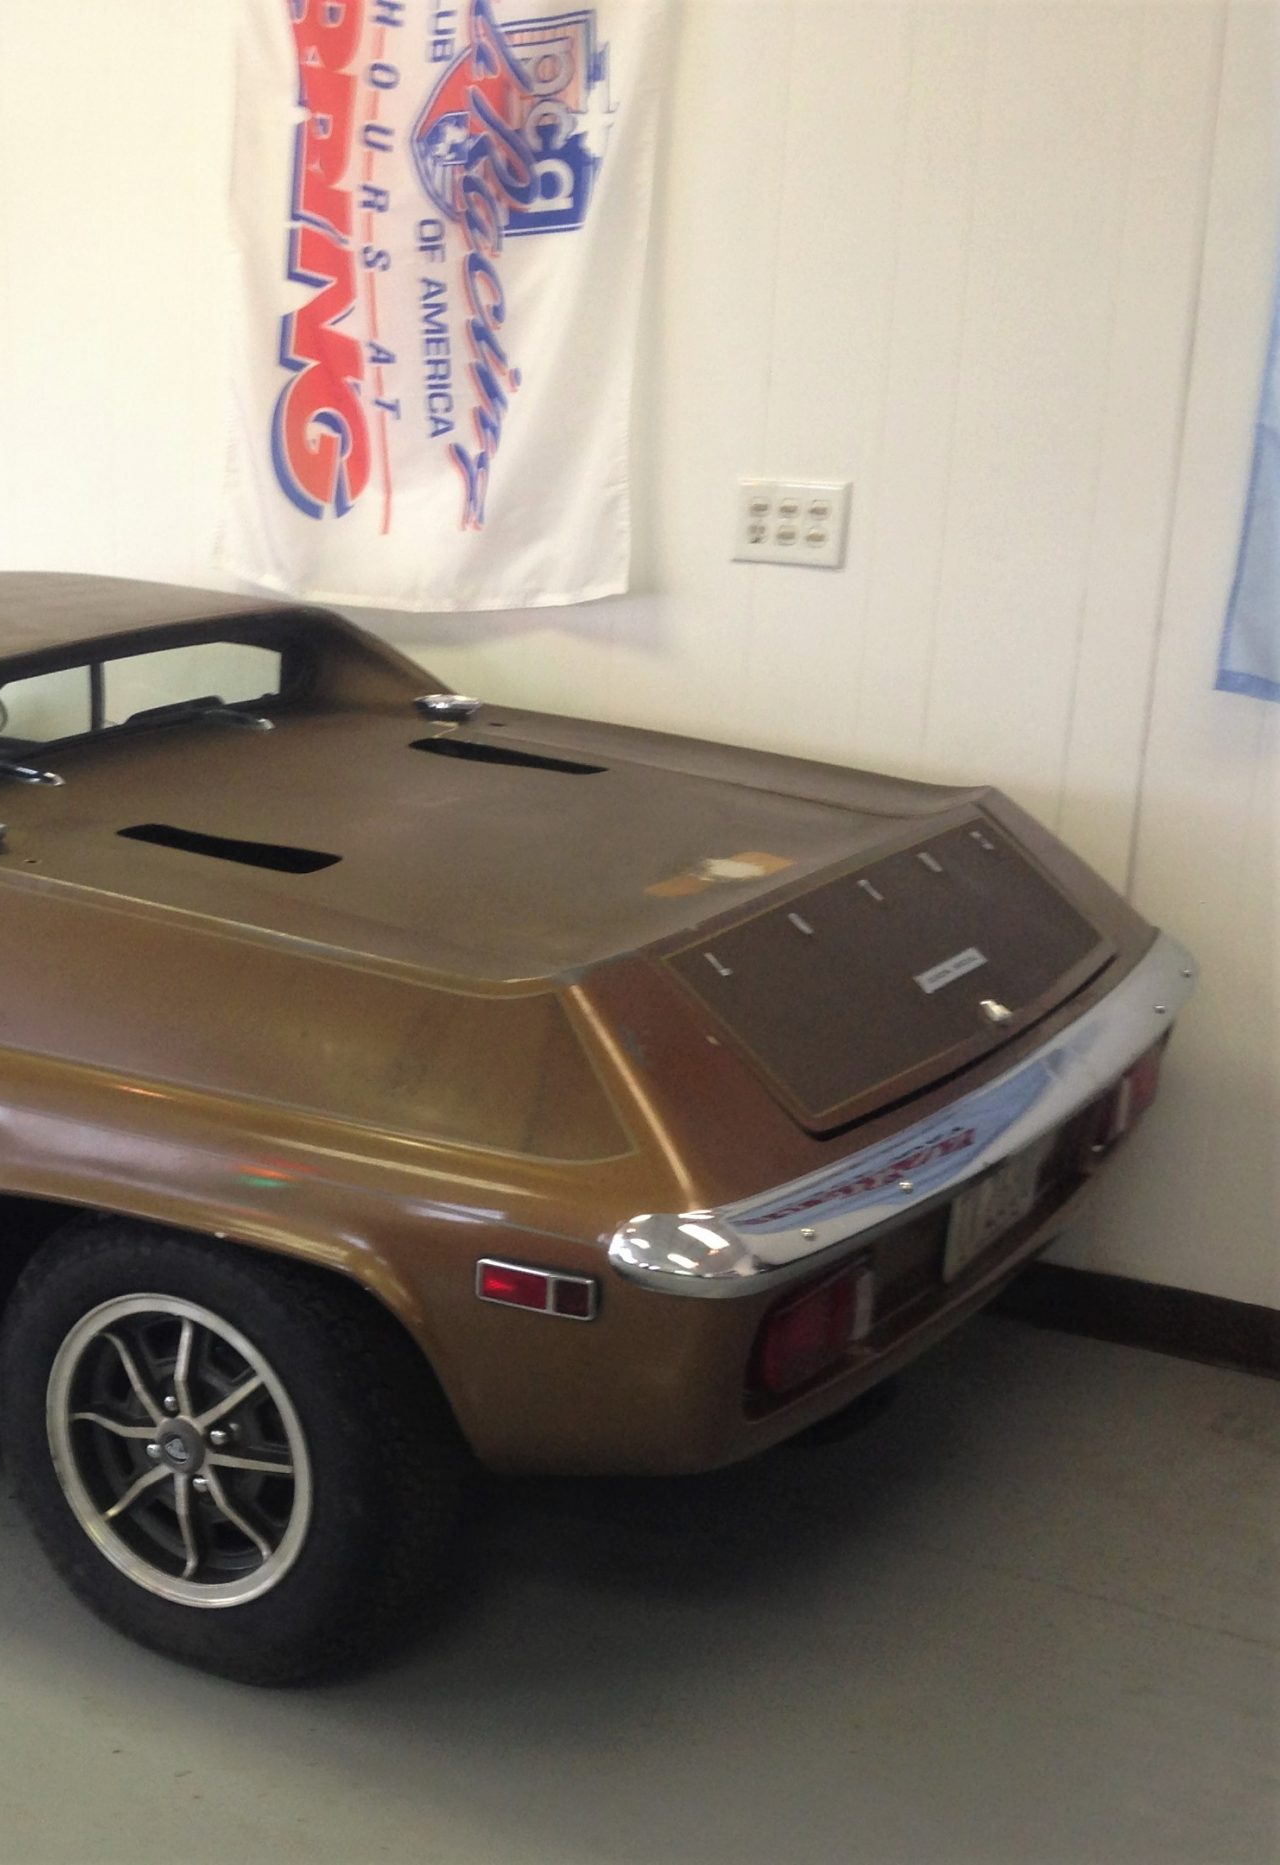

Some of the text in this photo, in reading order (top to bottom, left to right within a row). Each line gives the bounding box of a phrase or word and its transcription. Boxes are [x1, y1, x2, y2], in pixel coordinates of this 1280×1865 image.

[359, 0, 406, 419] HOURS AT
[417, 217, 447, 264] OF
[448, 85, 538, 531] Racing
[419, 277, 455, 438] AMERICA
